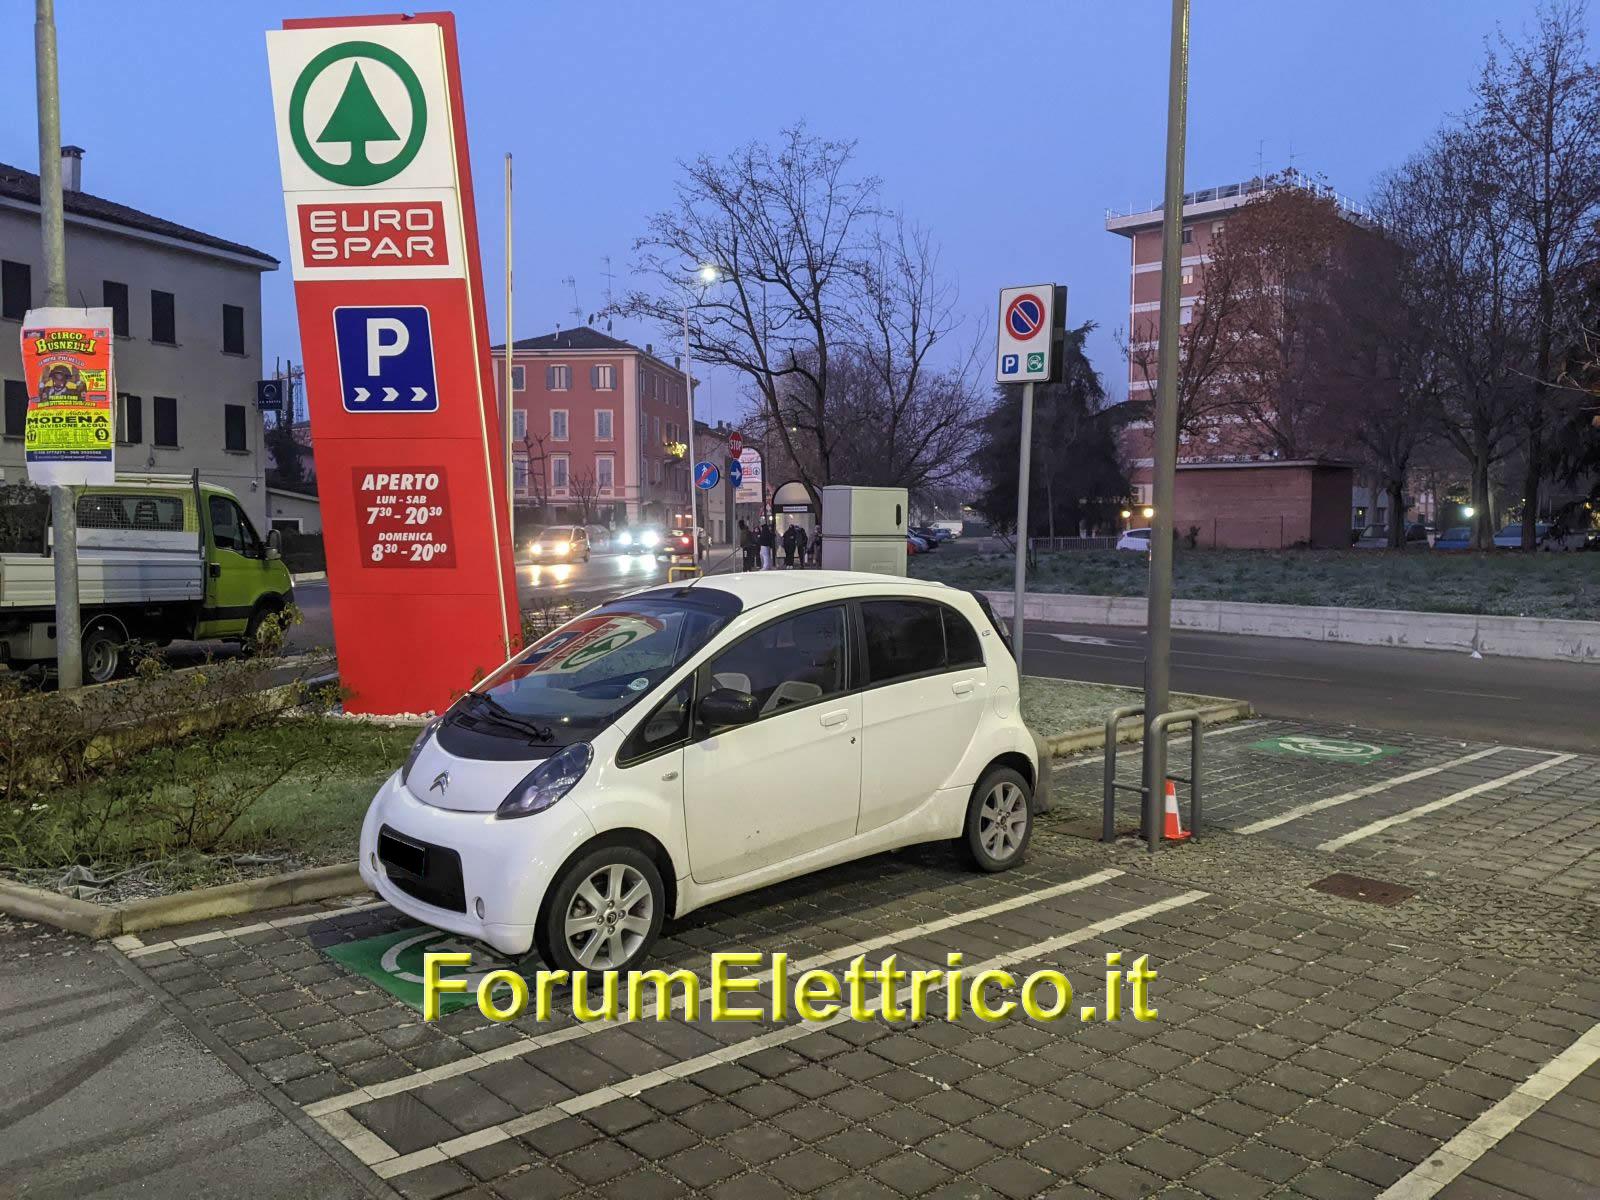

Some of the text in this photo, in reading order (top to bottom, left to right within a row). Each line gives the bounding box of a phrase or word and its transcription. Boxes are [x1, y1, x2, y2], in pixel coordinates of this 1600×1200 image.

[310, 208, 434, 233] EURO
[311, 236, 435, 260] SPAR
[51, 332, 83, 340] CIRCO
[35, 338, 96, 353] BUSNELLI
[366, 317, 410, 377] P
[1005, 356, 1016, 372] P
[27, 416, 109, 424] MODENA
[729, 439, 742, 451] STOP
[361, 473, 439, 490] APERTO
[376, 495, 396, 504] LUN
[406, 495, 427, 504] SAB
[378, 532, 433, 541] DOMENICA
